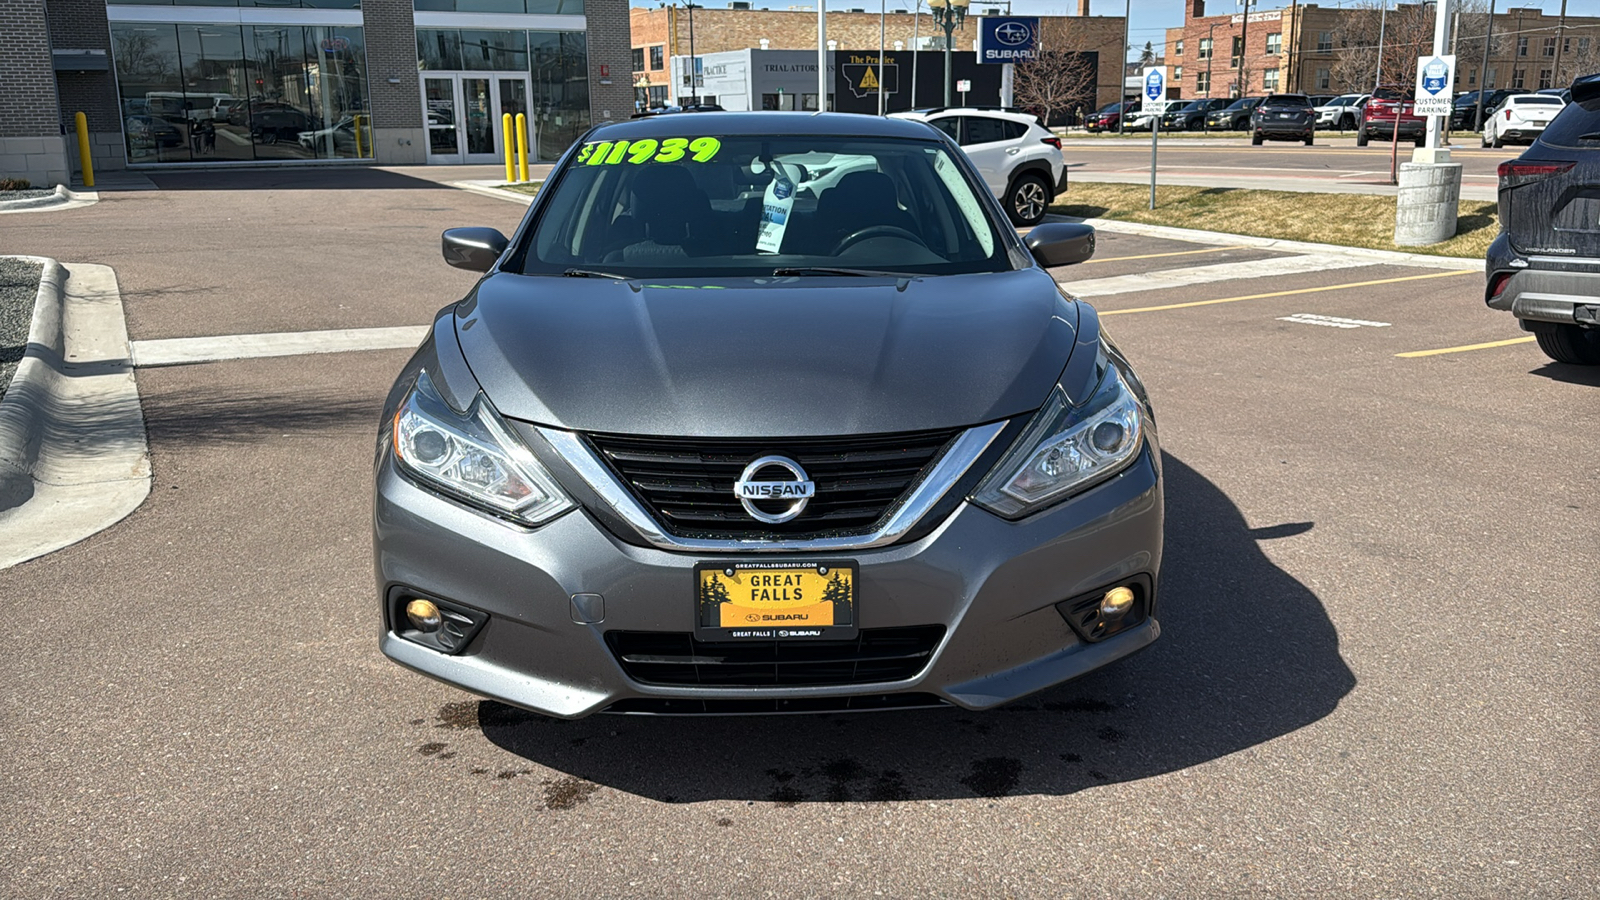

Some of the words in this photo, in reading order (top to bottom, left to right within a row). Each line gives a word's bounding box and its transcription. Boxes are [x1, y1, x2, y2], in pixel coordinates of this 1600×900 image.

[850, 55, 864, 64] The
[866, 55, 895, 64] Praice
[986, 49, 1035, 59] SUBARU
[703, 64, 728, 76] PRACTICE
[764, 64, 789, 72] TRIAL
[1415, 97, 1452, 105] CUSTOMER
[577, 137, 721, 165] $11939
[743, 484, 807, 496] NISSAN
[750, 574, 803, 587] GREAT
[751, 588, 803, 601] FALLS
[762, 613, 809, 621] SUBARU
